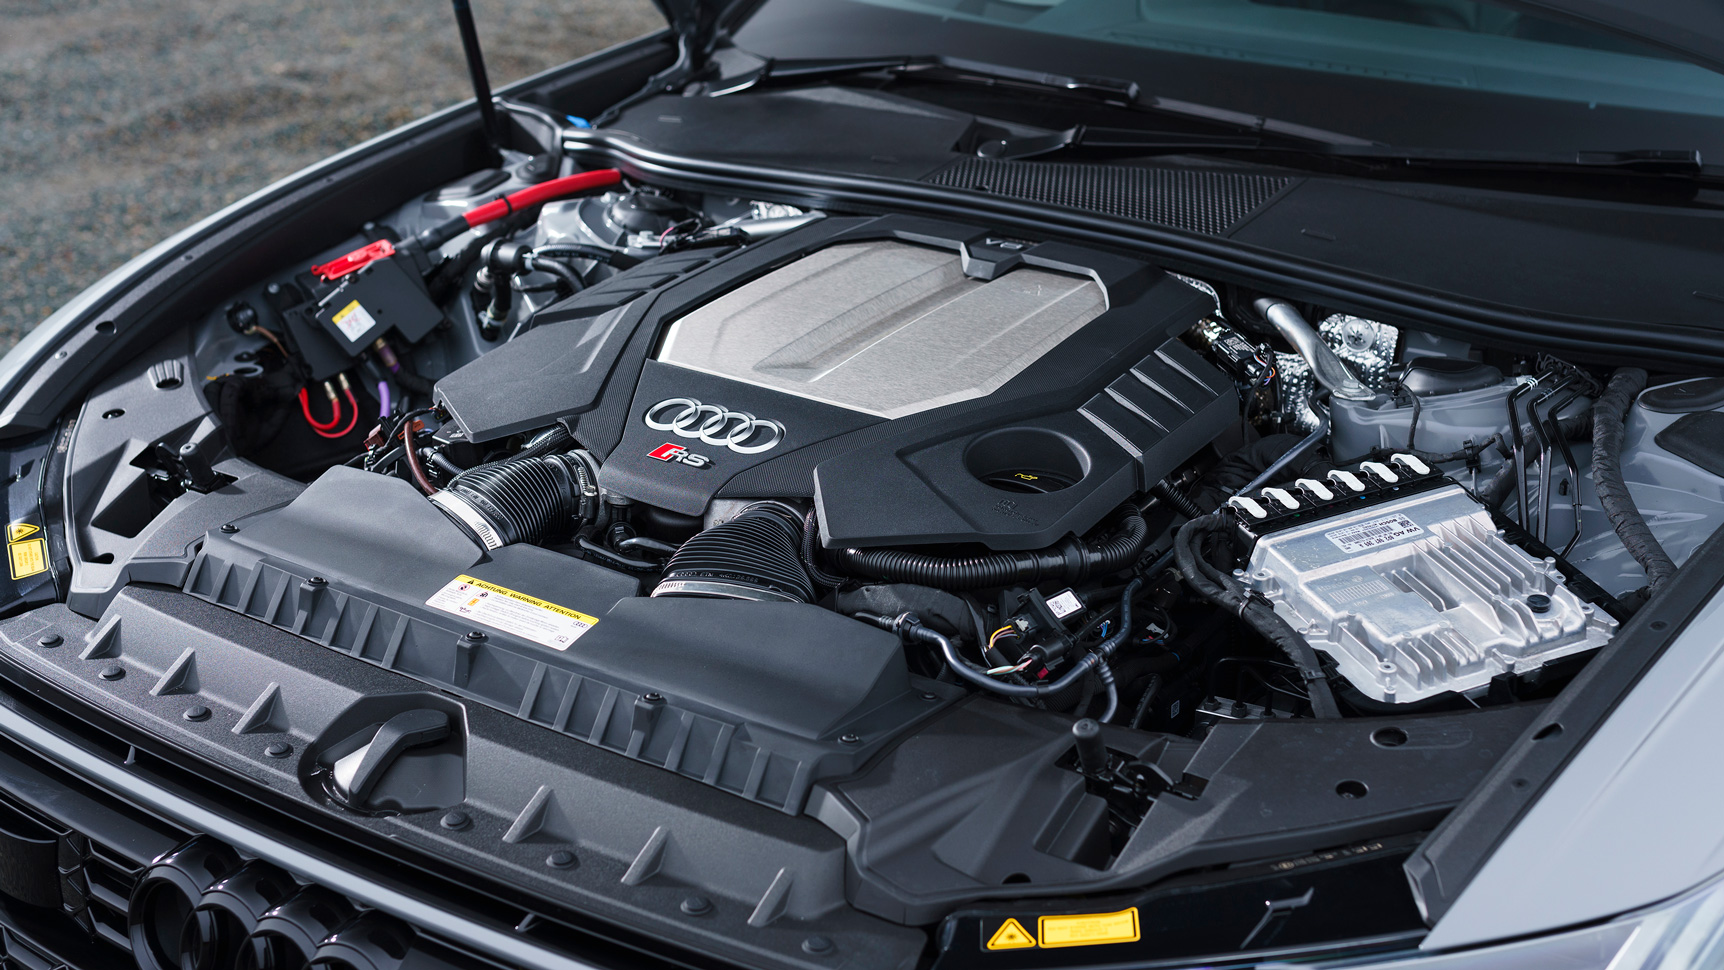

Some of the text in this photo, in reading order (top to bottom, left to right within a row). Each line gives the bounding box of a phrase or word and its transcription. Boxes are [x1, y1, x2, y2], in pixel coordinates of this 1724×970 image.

[659, 447, 710, 467] RS
[1379, 518, 1398, 526] BOSCH
[476, 582, 581, 620] ACHTUNG WARNING ATTENTION
